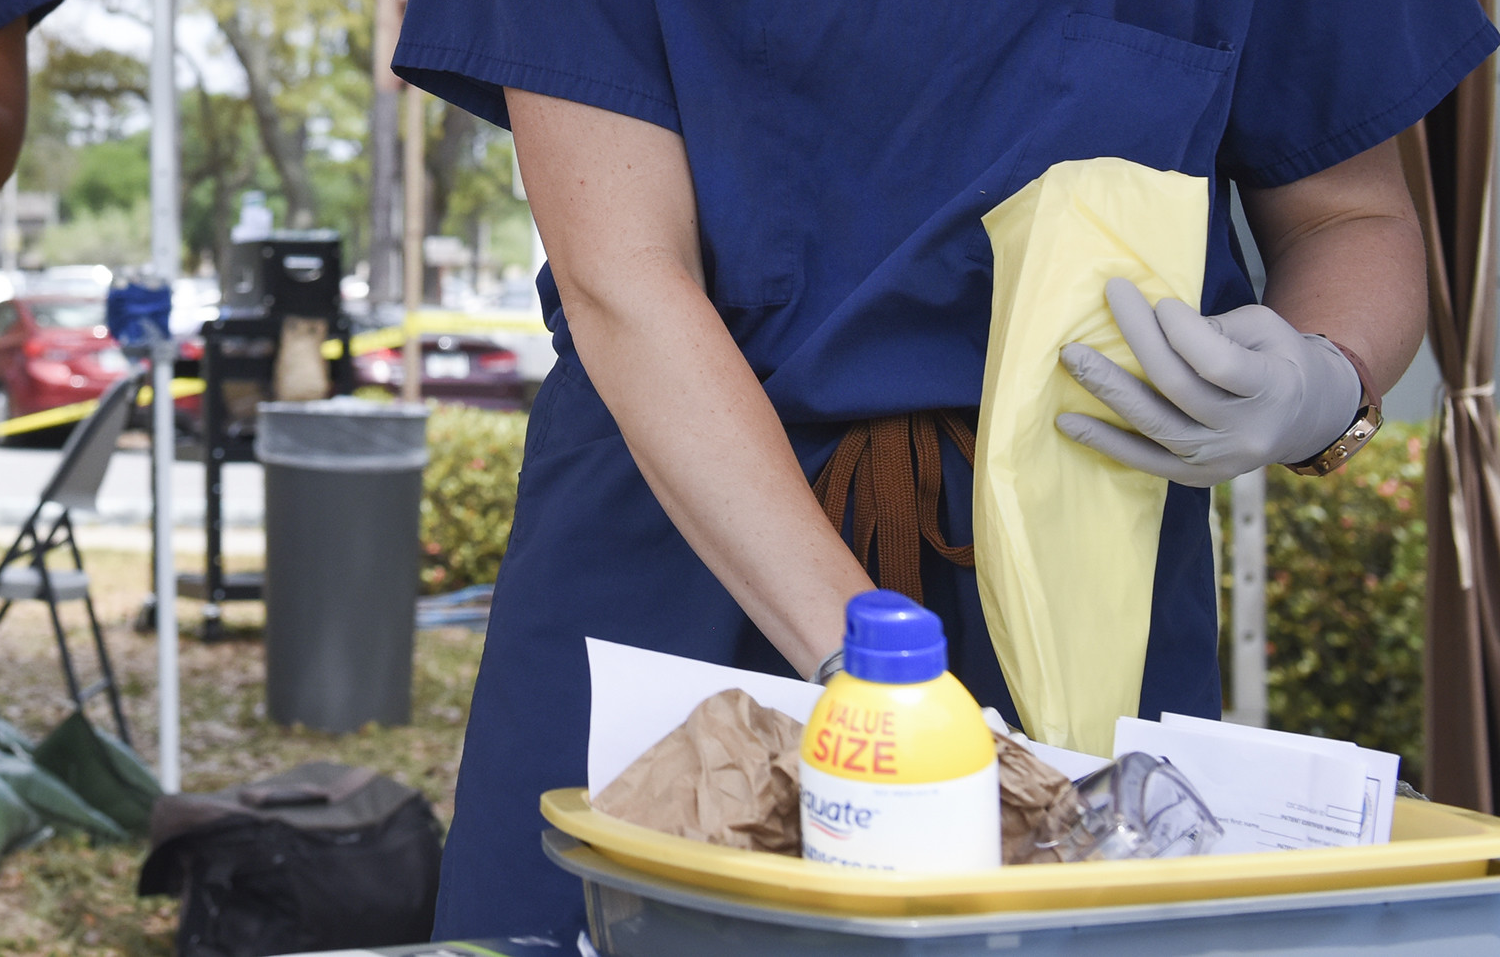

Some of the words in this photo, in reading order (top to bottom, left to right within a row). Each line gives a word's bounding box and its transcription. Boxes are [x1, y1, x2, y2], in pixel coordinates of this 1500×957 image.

[825, 698, 895, 736] VALUE
[813, 728, 897, 774] SIZE
[801, 789, 873, 830] quate
